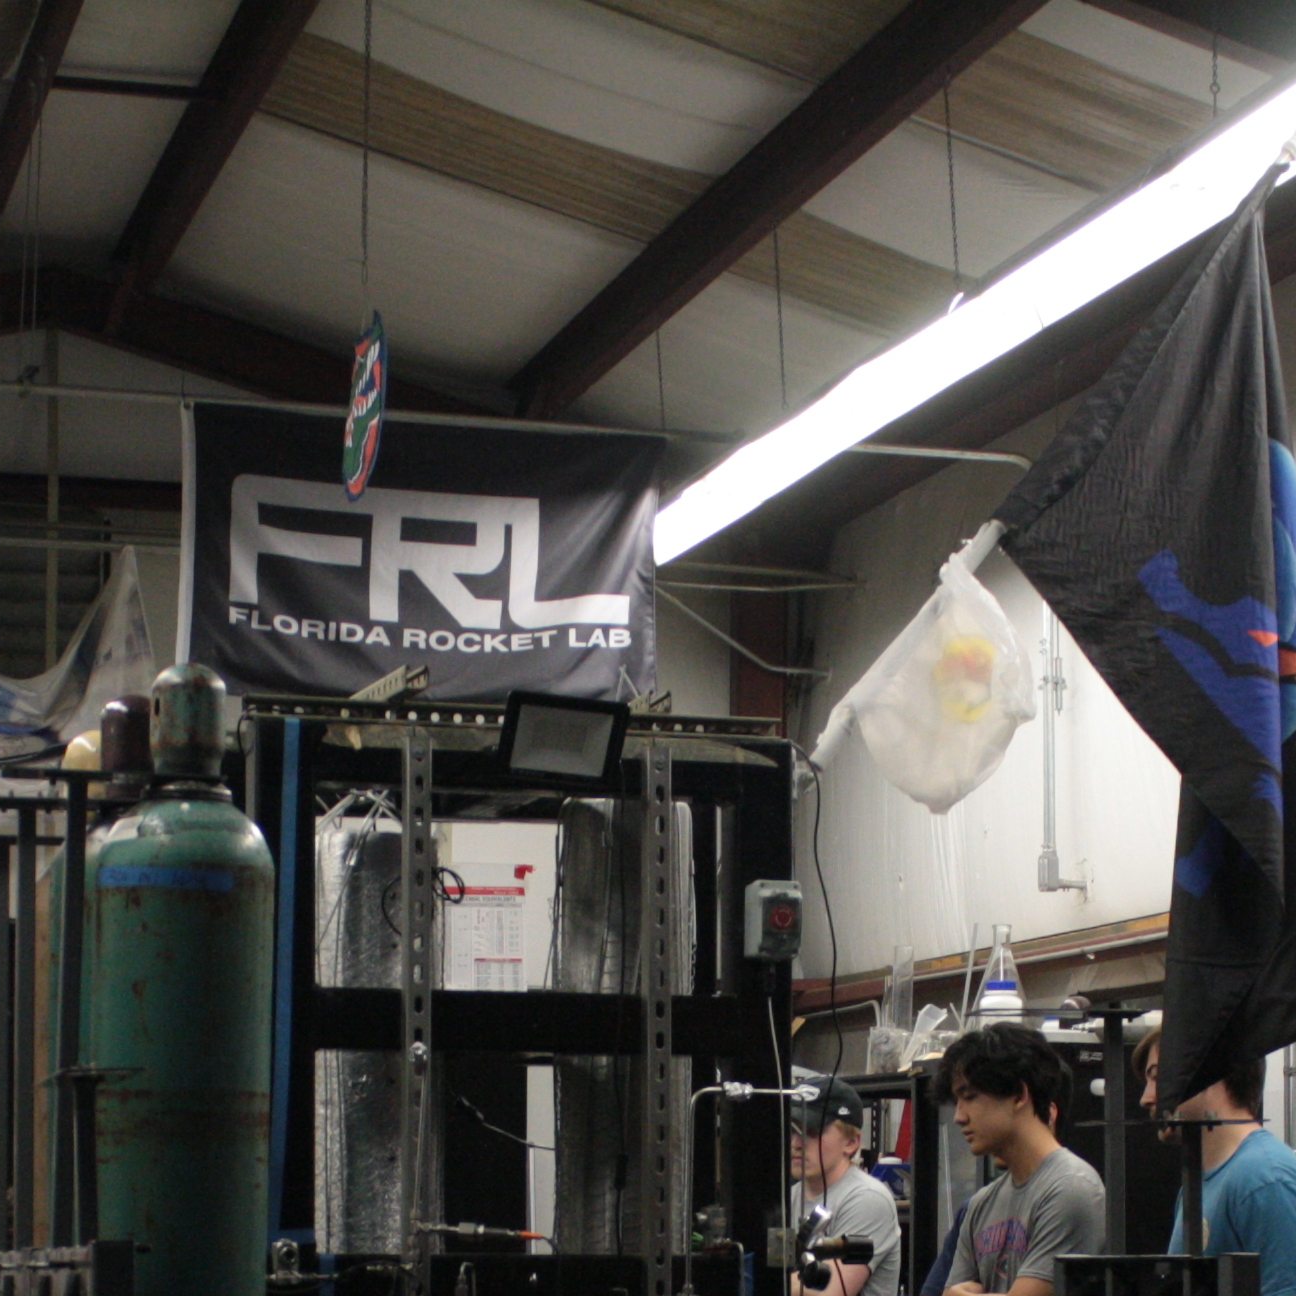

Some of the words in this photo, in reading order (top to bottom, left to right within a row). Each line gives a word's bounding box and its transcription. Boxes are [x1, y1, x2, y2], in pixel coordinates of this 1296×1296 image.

[229, 473, 630, 630] FRL
[229, 605, 391, 648] FLORIDA
[402, 617, 558, 654] ROCKET
[567, 617, 632, 649] LAB
